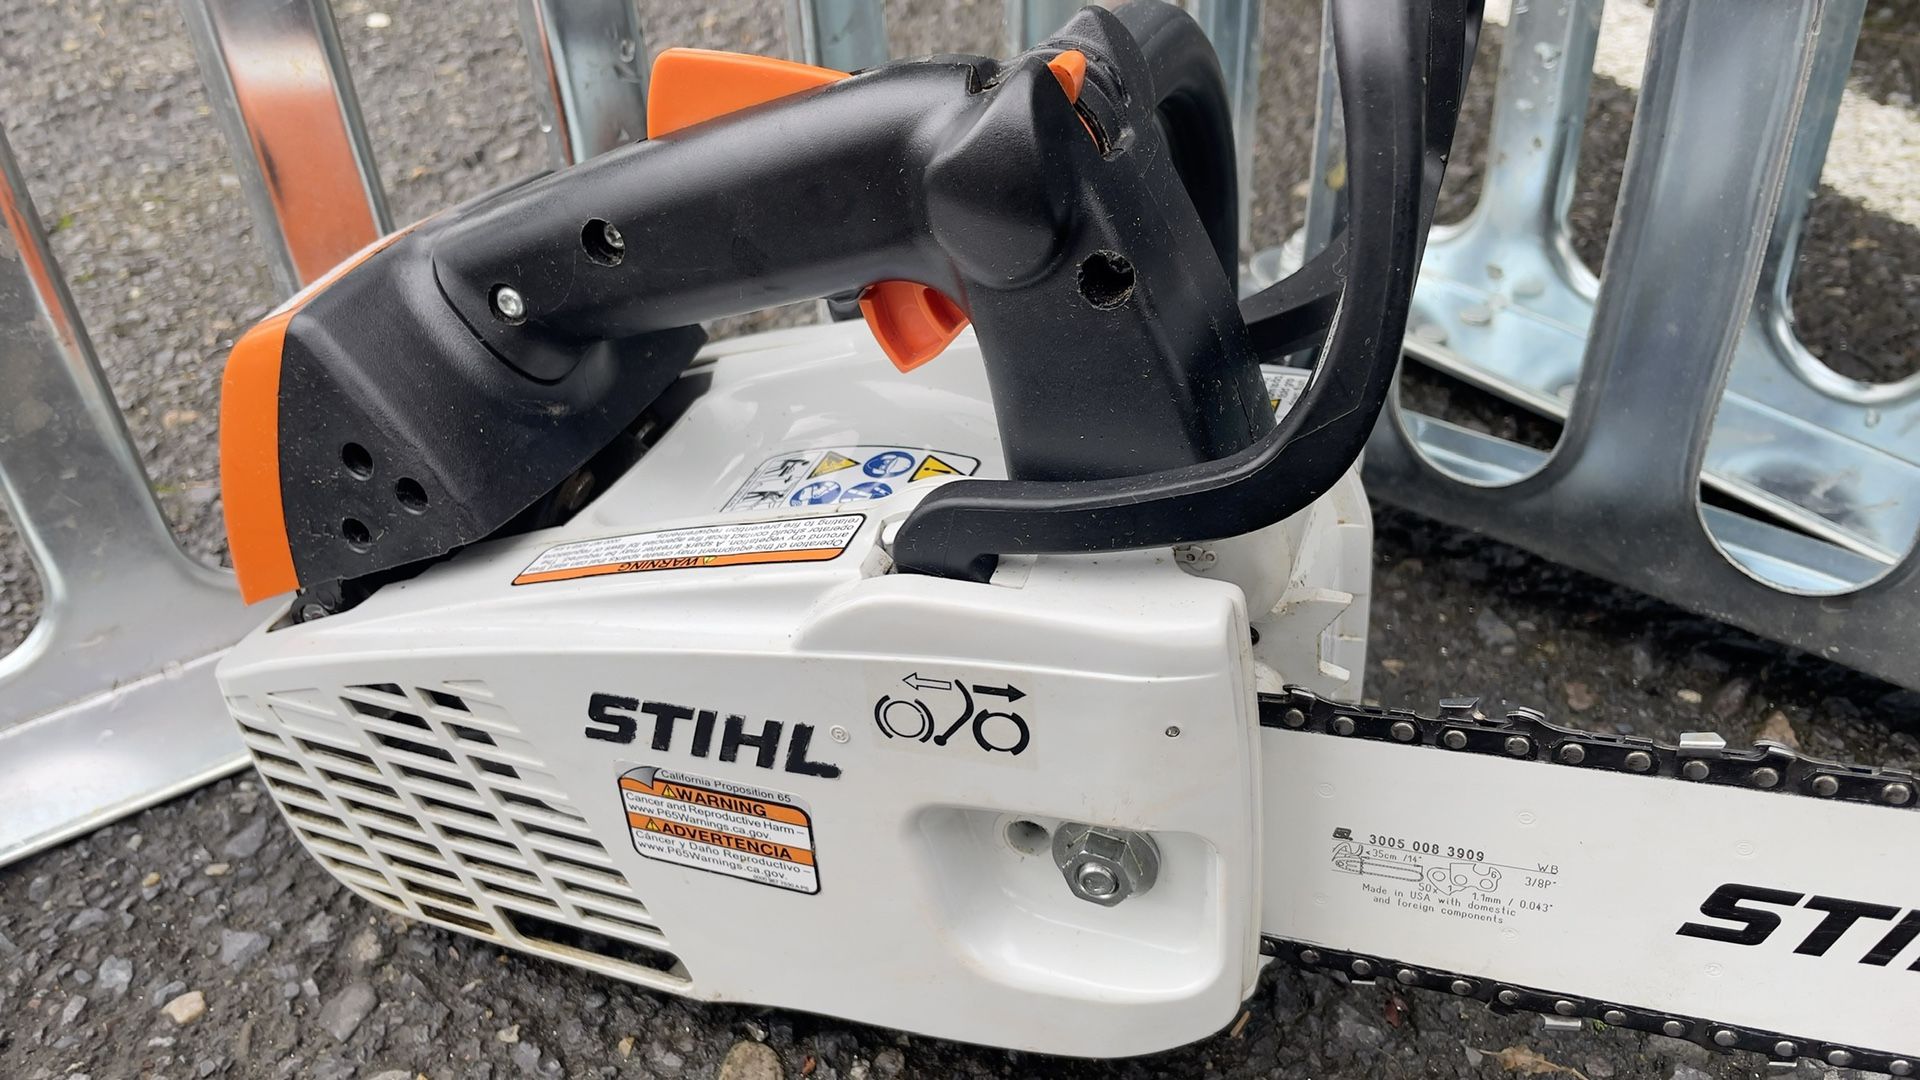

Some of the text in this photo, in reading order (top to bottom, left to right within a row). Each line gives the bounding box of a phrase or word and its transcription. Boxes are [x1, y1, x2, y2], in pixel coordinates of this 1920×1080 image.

[725, 522, 782, 533] prevention
[817, 518, 860, 527] relating
[771, 529, 807, 538] should
[809, 524, 855, 534] operator
[705, 534, 730, 542] local
[731, 530, 769, 539] contact
[788, 533, 807, 542] dry
[808, 532, 850, 541] around
[642, 537, 687, 546] agencies
[685, 540, 714, 549] spark
[790, 539, 843, 549] Operation
[620, 548, 641, 556] may
[642, 544, 683, 553] arrester
[697, 544, 754, 555] equipment
[757, 544, 774, 552] this
[775, 543, 787, 551] of
[642, 551, 673, 560] create
[675, 549, 694, 557] may
[618, 558, 699, 571] WARNING
[585, 691, 842, 779] STIHL
[660, 769, 792, 803] California Proposition 65
[676, 787, 767, 817] WARNING
[626, 792, 663, 807] Cancer
[666, 802, 687, 812] and
[688, 804, 762, 827] Reproductive
[763, 821, 795, 834] Harm
[628, 803, 772, 840] www.P65Warnings.ca.gov.
[662, 822, 793, 861] ADVERTENCIA
[635, 830, 674, 845] Cáncer
[679, 841, 686, 849] y
[690, 842, 720, 856] Daño
[723, 849, 801, 873] Reproductivo
[1369, 834, 1485, 862] 3005 008 3909
[637, 840, 788, 880] www.P65Warnings.ca.gov.
[1491, 870, 1497, 879] 6
[1418, 882, 1438, 895] 50x
[1362, 883, 1516, 917] Made in USA with domestic
[1472, 892, 1501, 905] 1.1mm
[1373, 896, 1503, 924] and foreign components
[1675, 882, 1920, 972] STI
